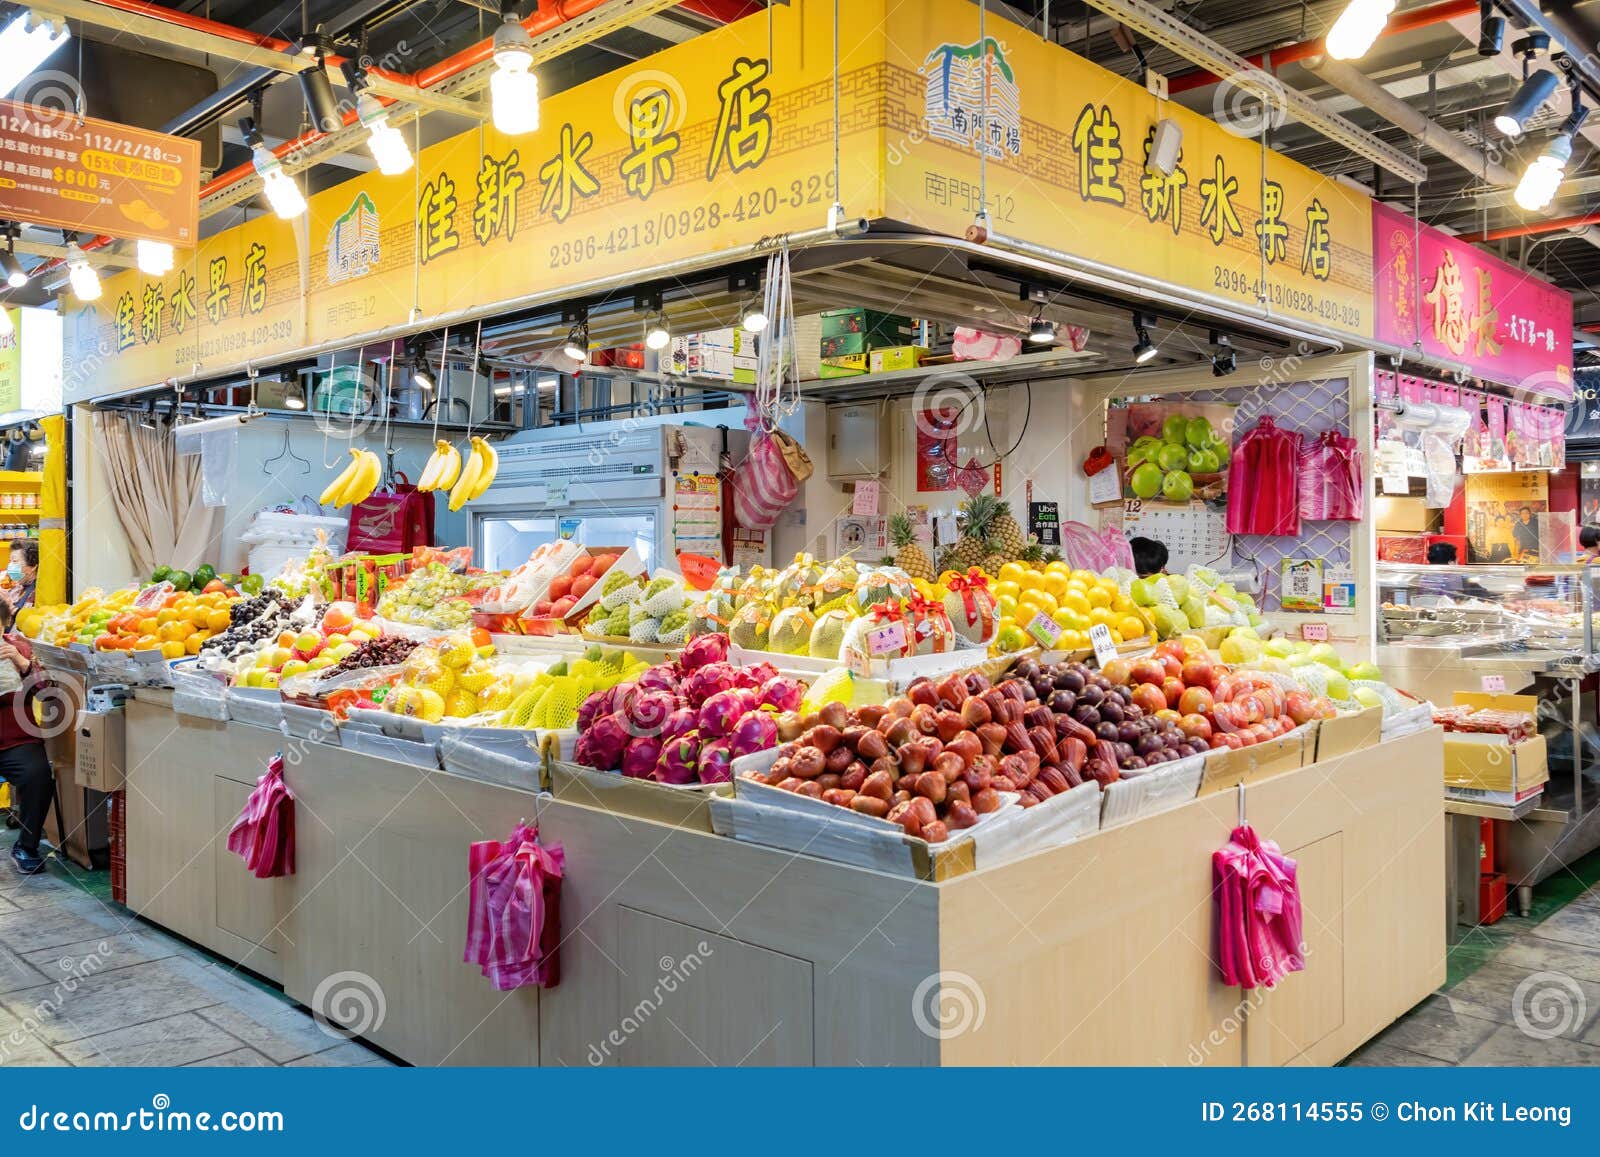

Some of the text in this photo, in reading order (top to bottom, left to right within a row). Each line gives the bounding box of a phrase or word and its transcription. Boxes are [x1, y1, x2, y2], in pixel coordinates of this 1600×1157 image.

[951, 106, 1020, 154] 南門市場
[417, 57, 772, 265] 佳新水果店
[549, 172, 837, 269] 2396-4213/0928-420-329
[114, 243, 268, 354] 佳新水果店
[1038, 504, 1056, 513] Uber
[1038, 512, 1056, 521] Eats
[1125, 500, 1141, 513] 12
